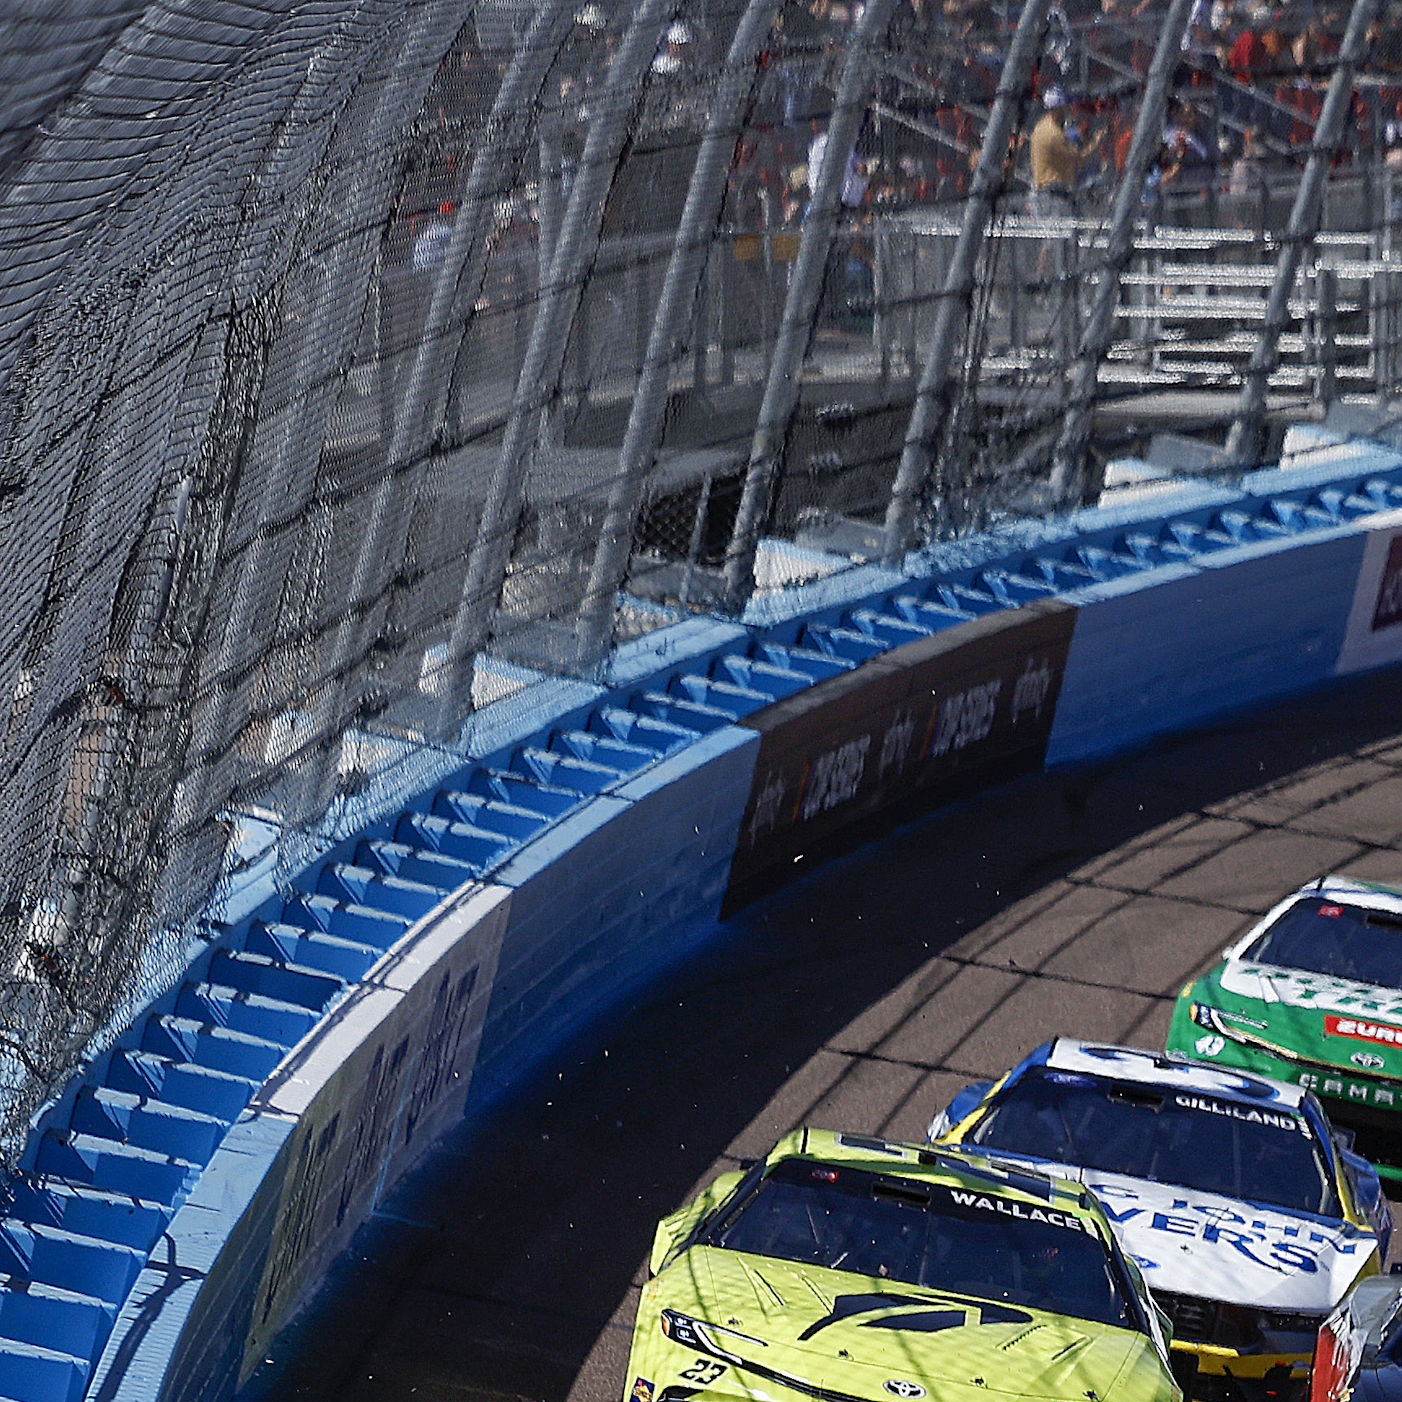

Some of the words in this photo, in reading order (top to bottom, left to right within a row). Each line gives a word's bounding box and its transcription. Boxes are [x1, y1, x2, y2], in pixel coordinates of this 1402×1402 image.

[1175, 1094, 1297, 1132] GILLILAND
[950, 1190, 1082, 1231] WALLACE
[1100, 1200, 1320, 1276] VERS
[678, 1358, 730, 1385] 23
